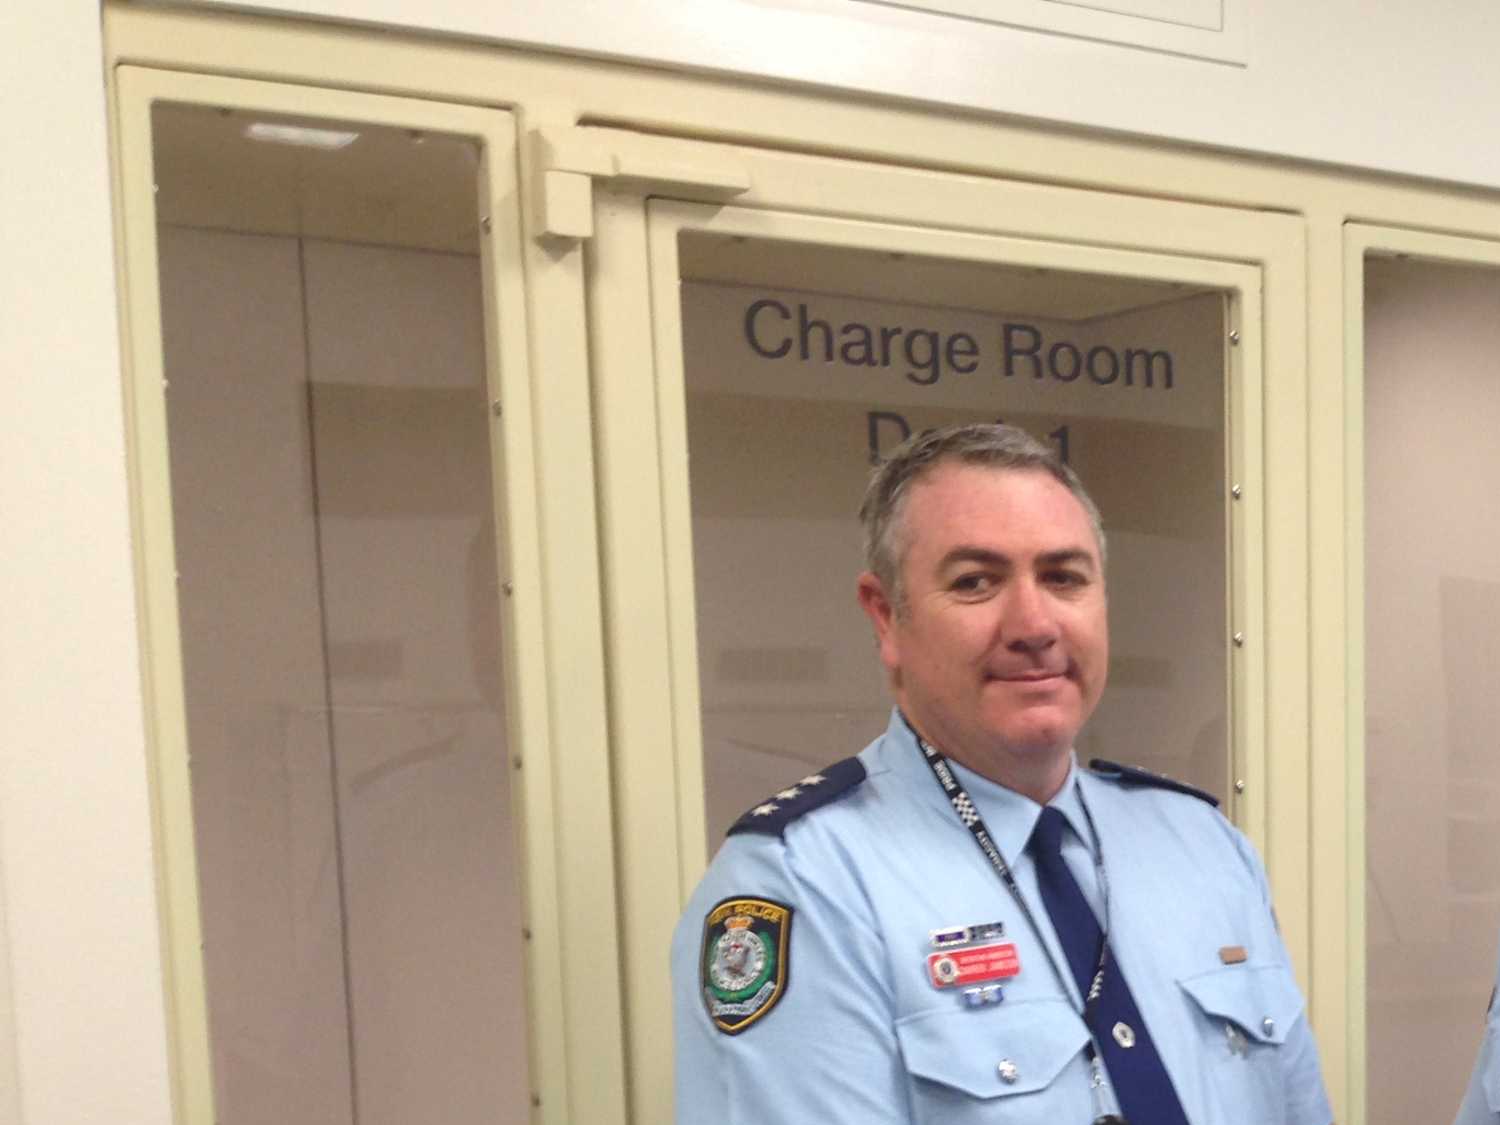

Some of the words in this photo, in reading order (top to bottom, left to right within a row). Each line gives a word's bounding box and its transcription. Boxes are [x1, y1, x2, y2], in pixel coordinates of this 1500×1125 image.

[744, 298, 980, 386] Charge
[1002, 323, 1174, 390] Room
[1049, 425, 1071, 464] 1
